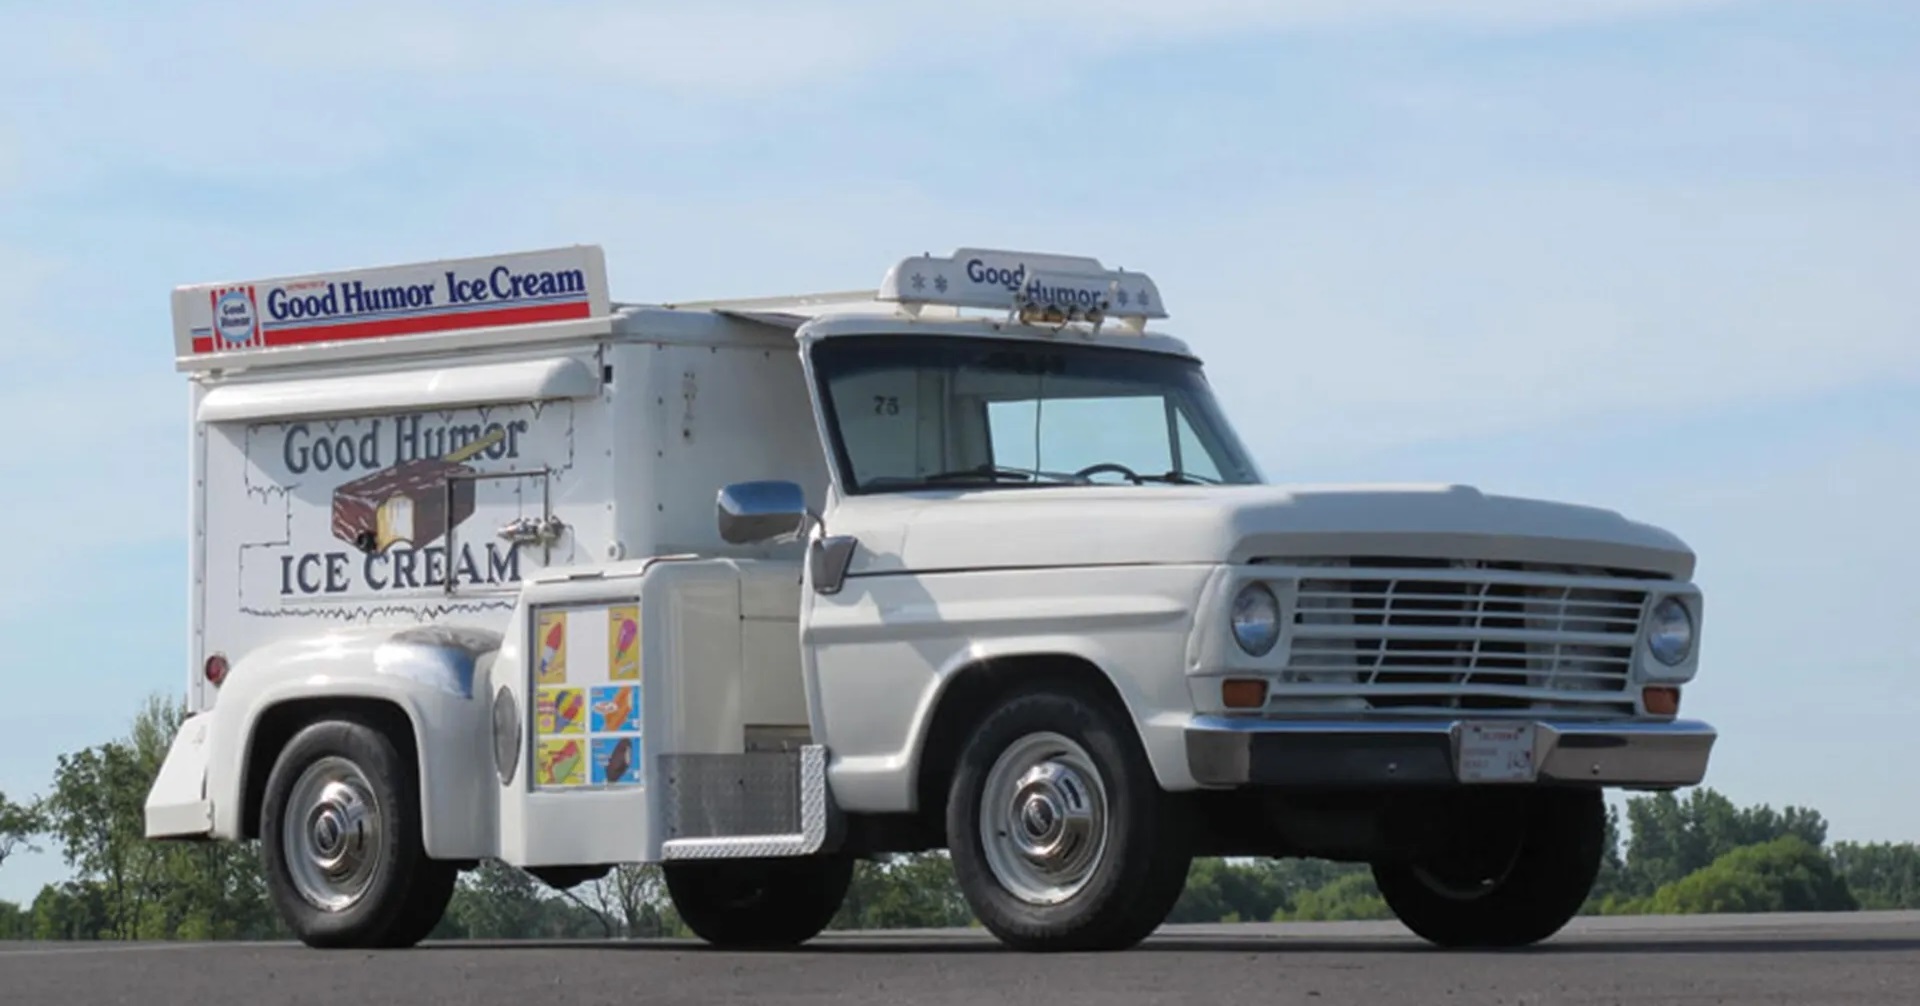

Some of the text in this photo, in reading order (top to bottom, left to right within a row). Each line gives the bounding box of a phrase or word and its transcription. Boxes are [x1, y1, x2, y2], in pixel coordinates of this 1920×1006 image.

[268, 266, 585, 320] Good Humor Ice Cream
[967, 259, 1102, 307] Good Humor
[284, 414, 528, 475] Good Humor
[280, 541, 521, 594] ICE CREAM
